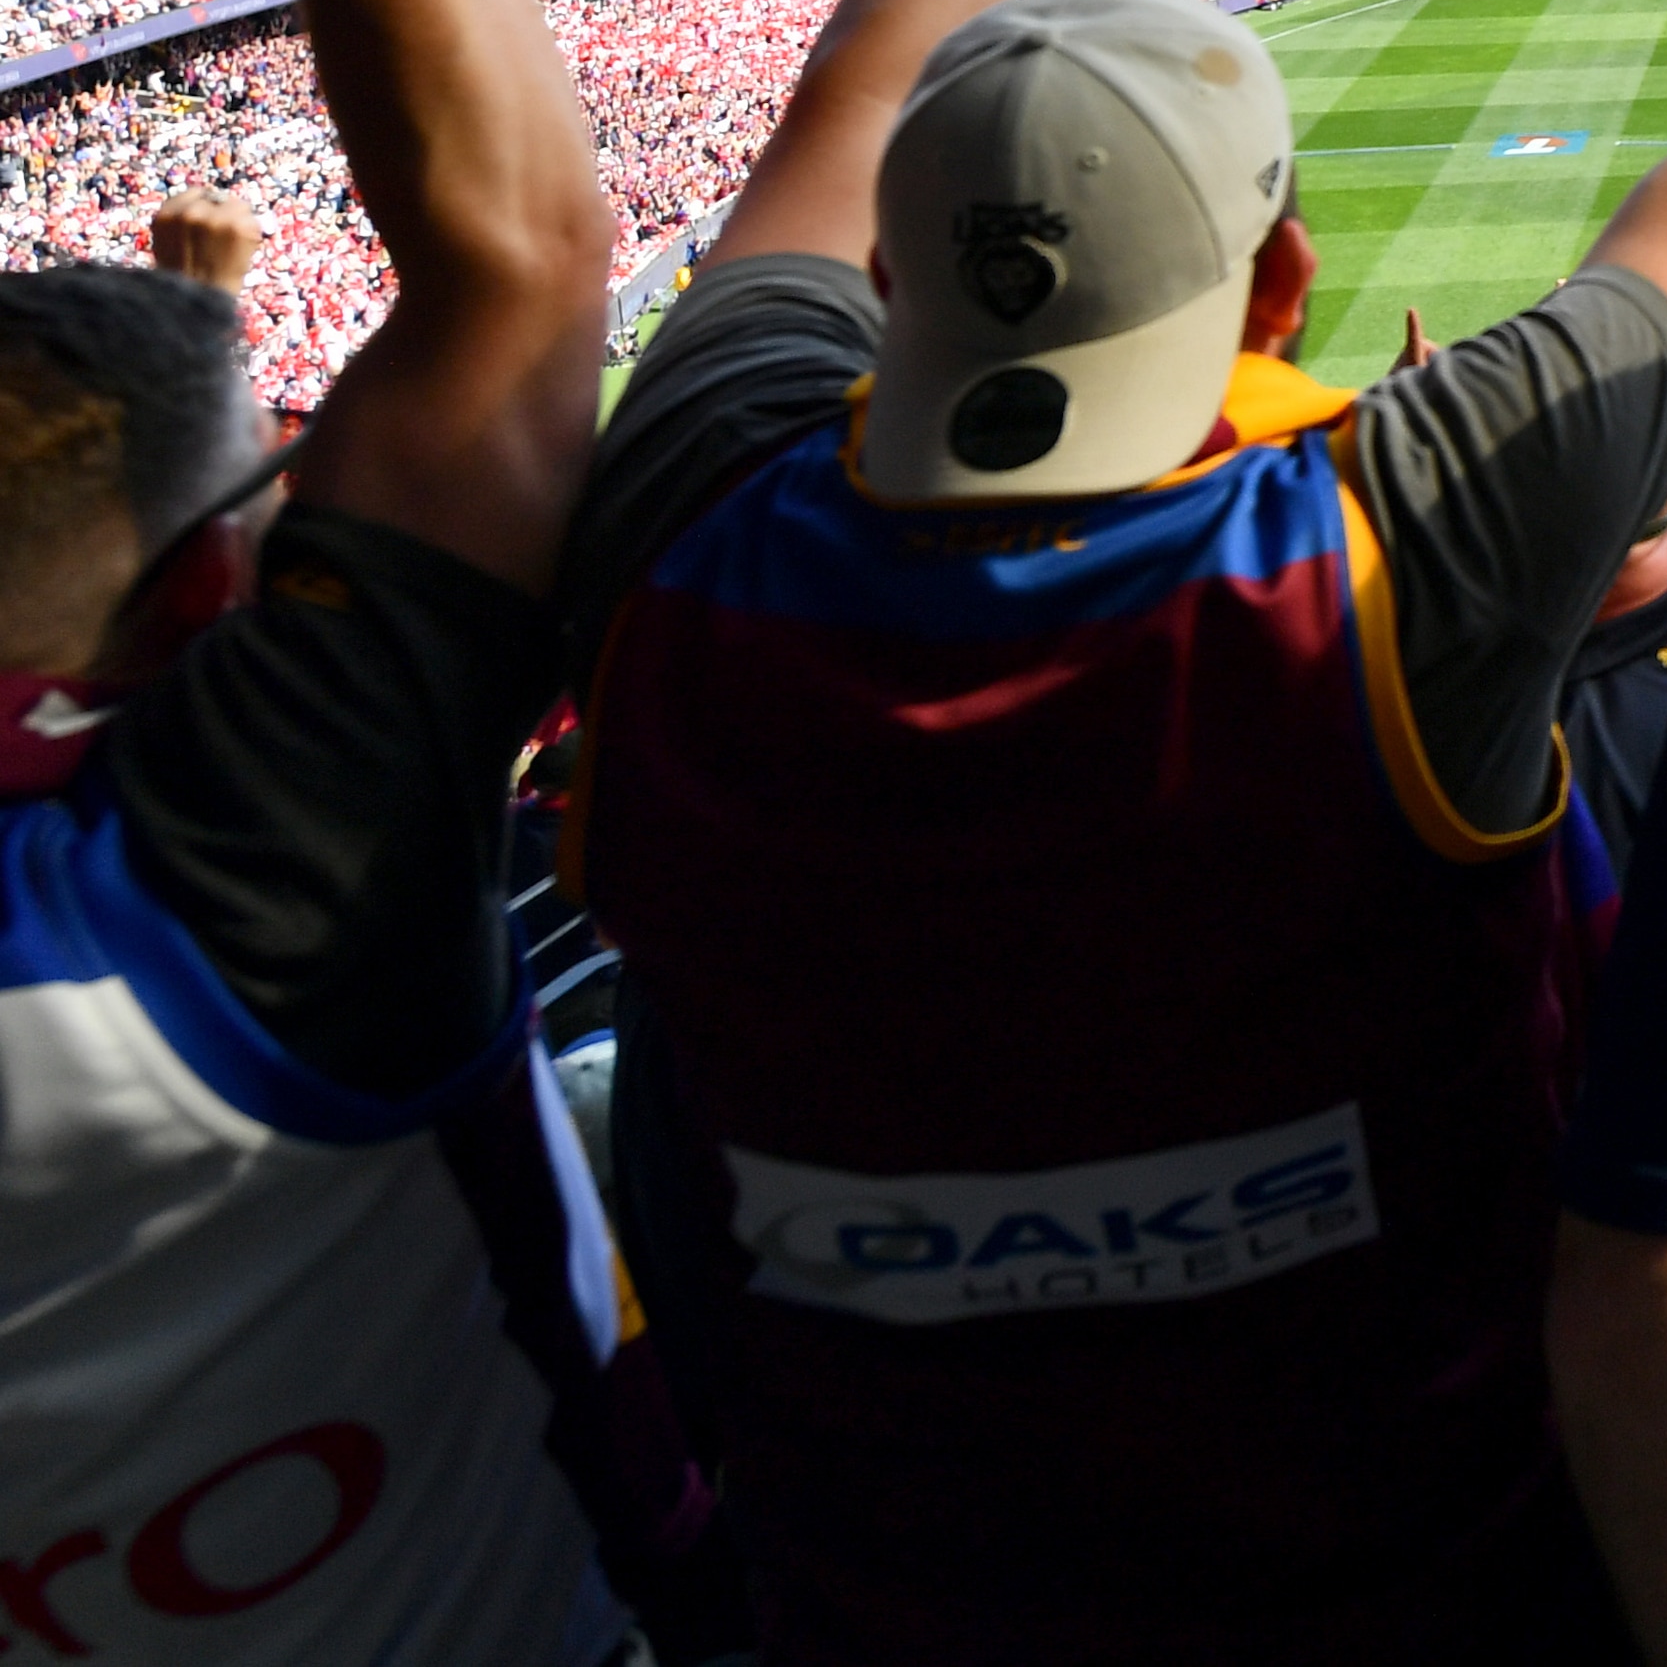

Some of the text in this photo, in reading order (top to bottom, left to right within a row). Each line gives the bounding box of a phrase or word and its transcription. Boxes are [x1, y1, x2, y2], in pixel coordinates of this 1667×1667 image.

[836, 1143, 1356, 1271] OAKS
[962, 1206, 1358, 1302] HOTELS
[0, 1420, 387, 1658] ro
